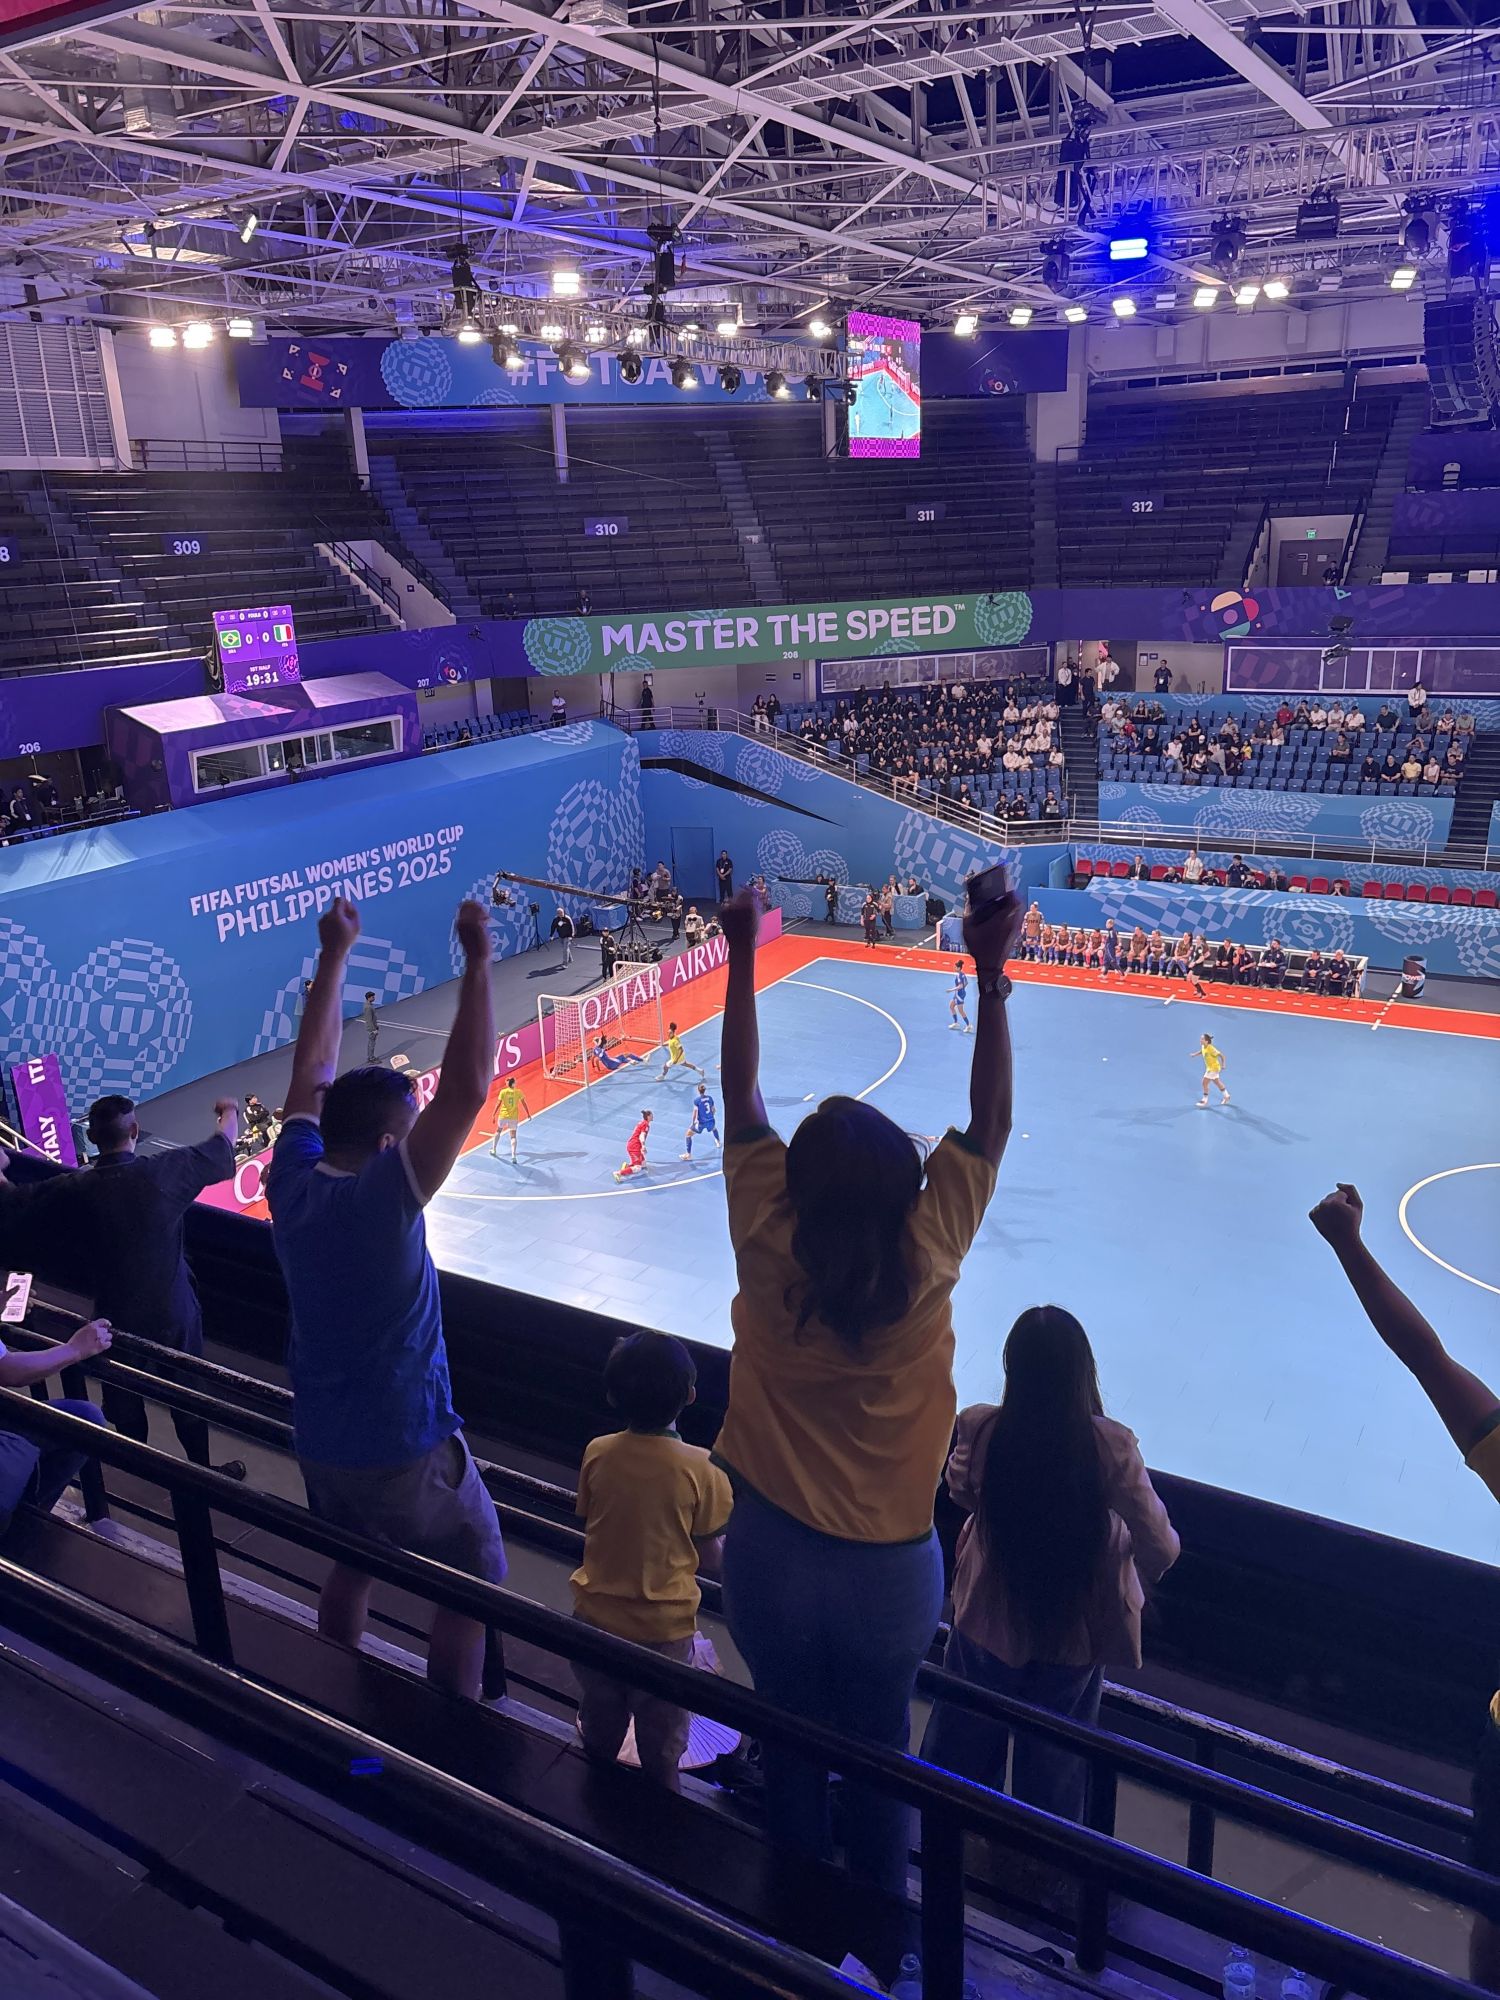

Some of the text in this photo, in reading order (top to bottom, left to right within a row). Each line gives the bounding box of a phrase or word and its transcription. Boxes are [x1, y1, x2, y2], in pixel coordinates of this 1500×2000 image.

[1131, 500, 1154, 513] 312
[917, 510, 935, 522] 311
[595, 523, 618, 536] 310
[173, 540, 201, 556] 309
[245, 632, 270, 644] 0 0
[601, 617, 759, 656] MASTER
[766, 612, 840, 646] THE
[782, 650, 799, 659] 208
[246, 671, 279, 687] 19:31
[417, 678, 430, 687] 207
[19, 741, 41, 754] 206
[190, 824, 464, 916] FIFA FUTSAL WOMEN'S WORLD CUP
[216, 866, 394, 943] PHILIPPINES
[582, 933, 730, 1030] QATAR AIRW
[704, 1102, 711, 1115] 3
